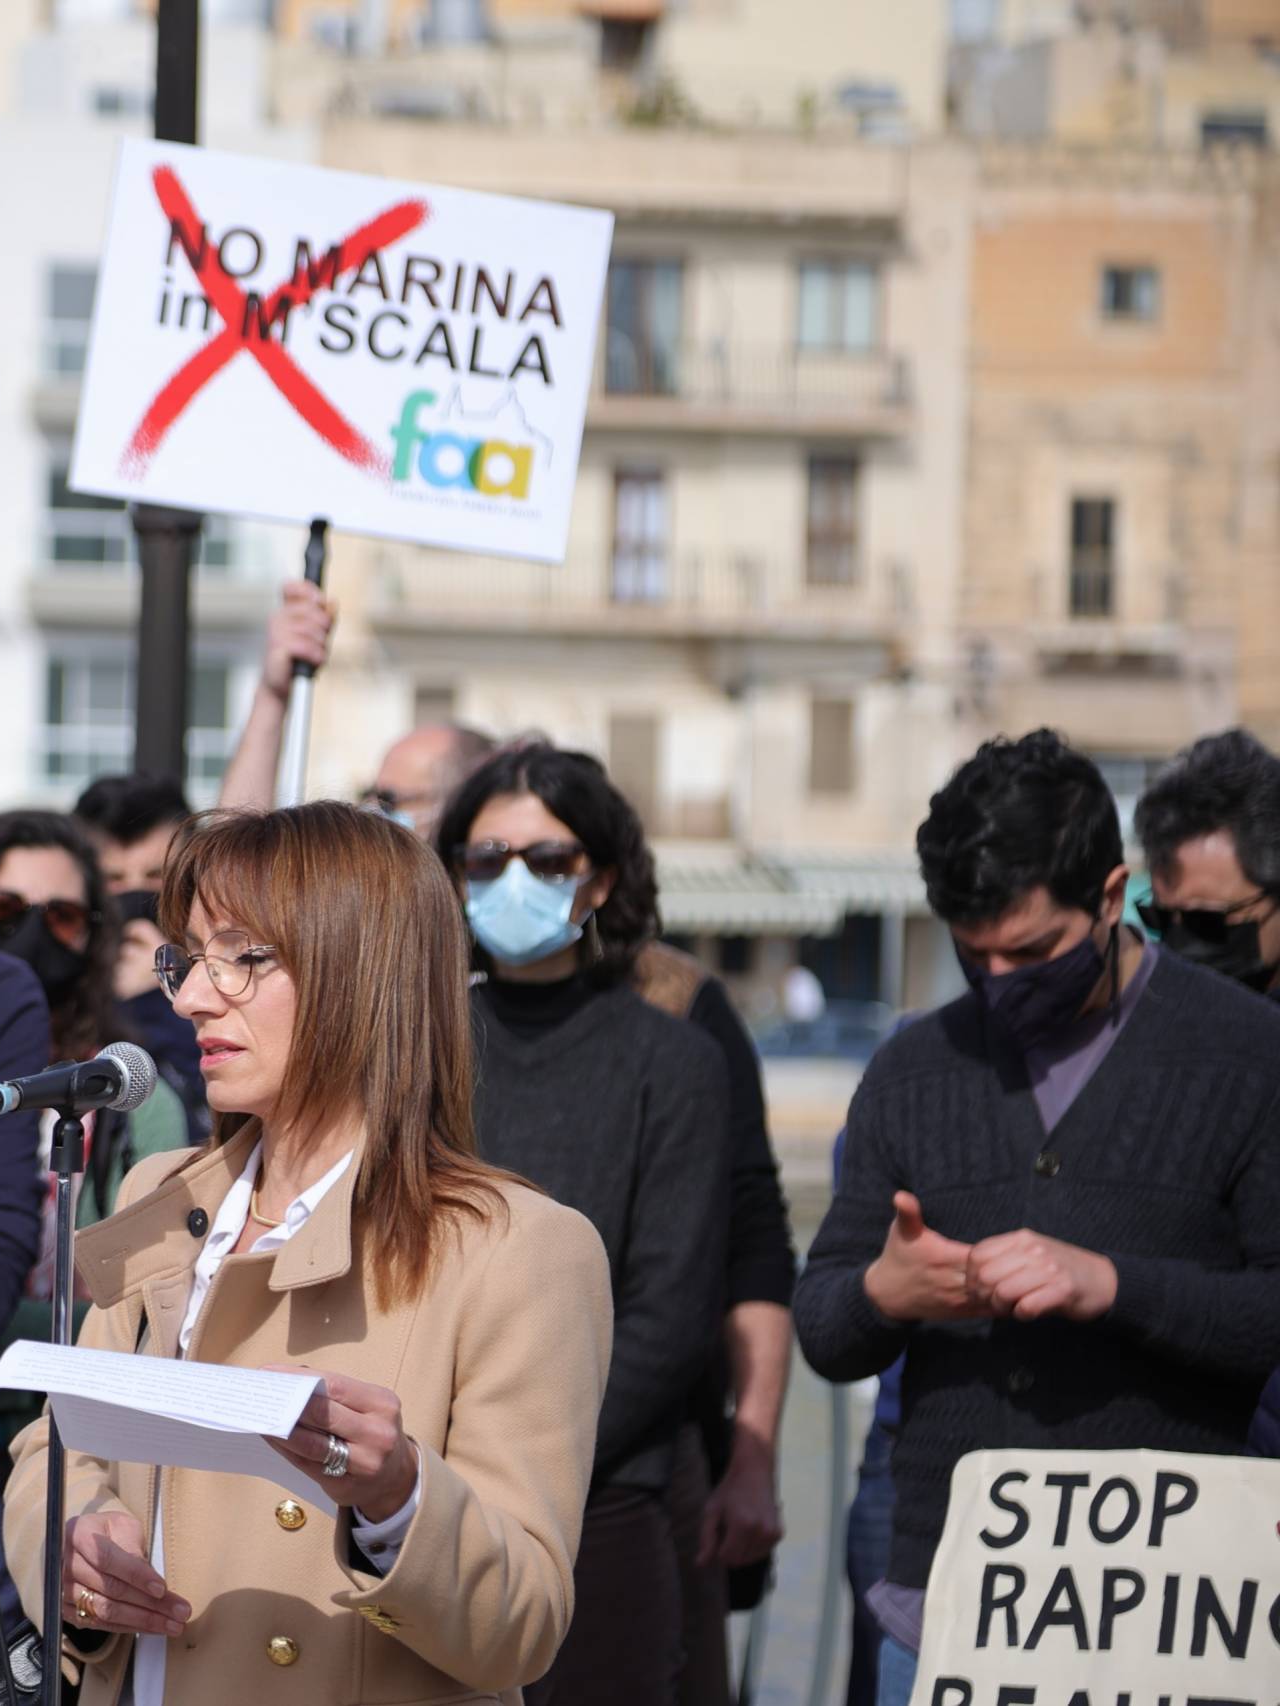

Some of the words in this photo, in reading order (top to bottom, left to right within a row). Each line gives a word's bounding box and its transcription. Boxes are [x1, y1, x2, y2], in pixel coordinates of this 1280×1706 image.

[166, 219, 263, 278] NO
[291, 239, 562, 328] MARINA
[158, 275, 211, 331] in
[241, 292, 553, 385] M'SCALA
[390, 388, 534, 500] faa
[978, 1471, 1200, 1549] STOP
[975, 1564, 1280, 1659] RAPIN
